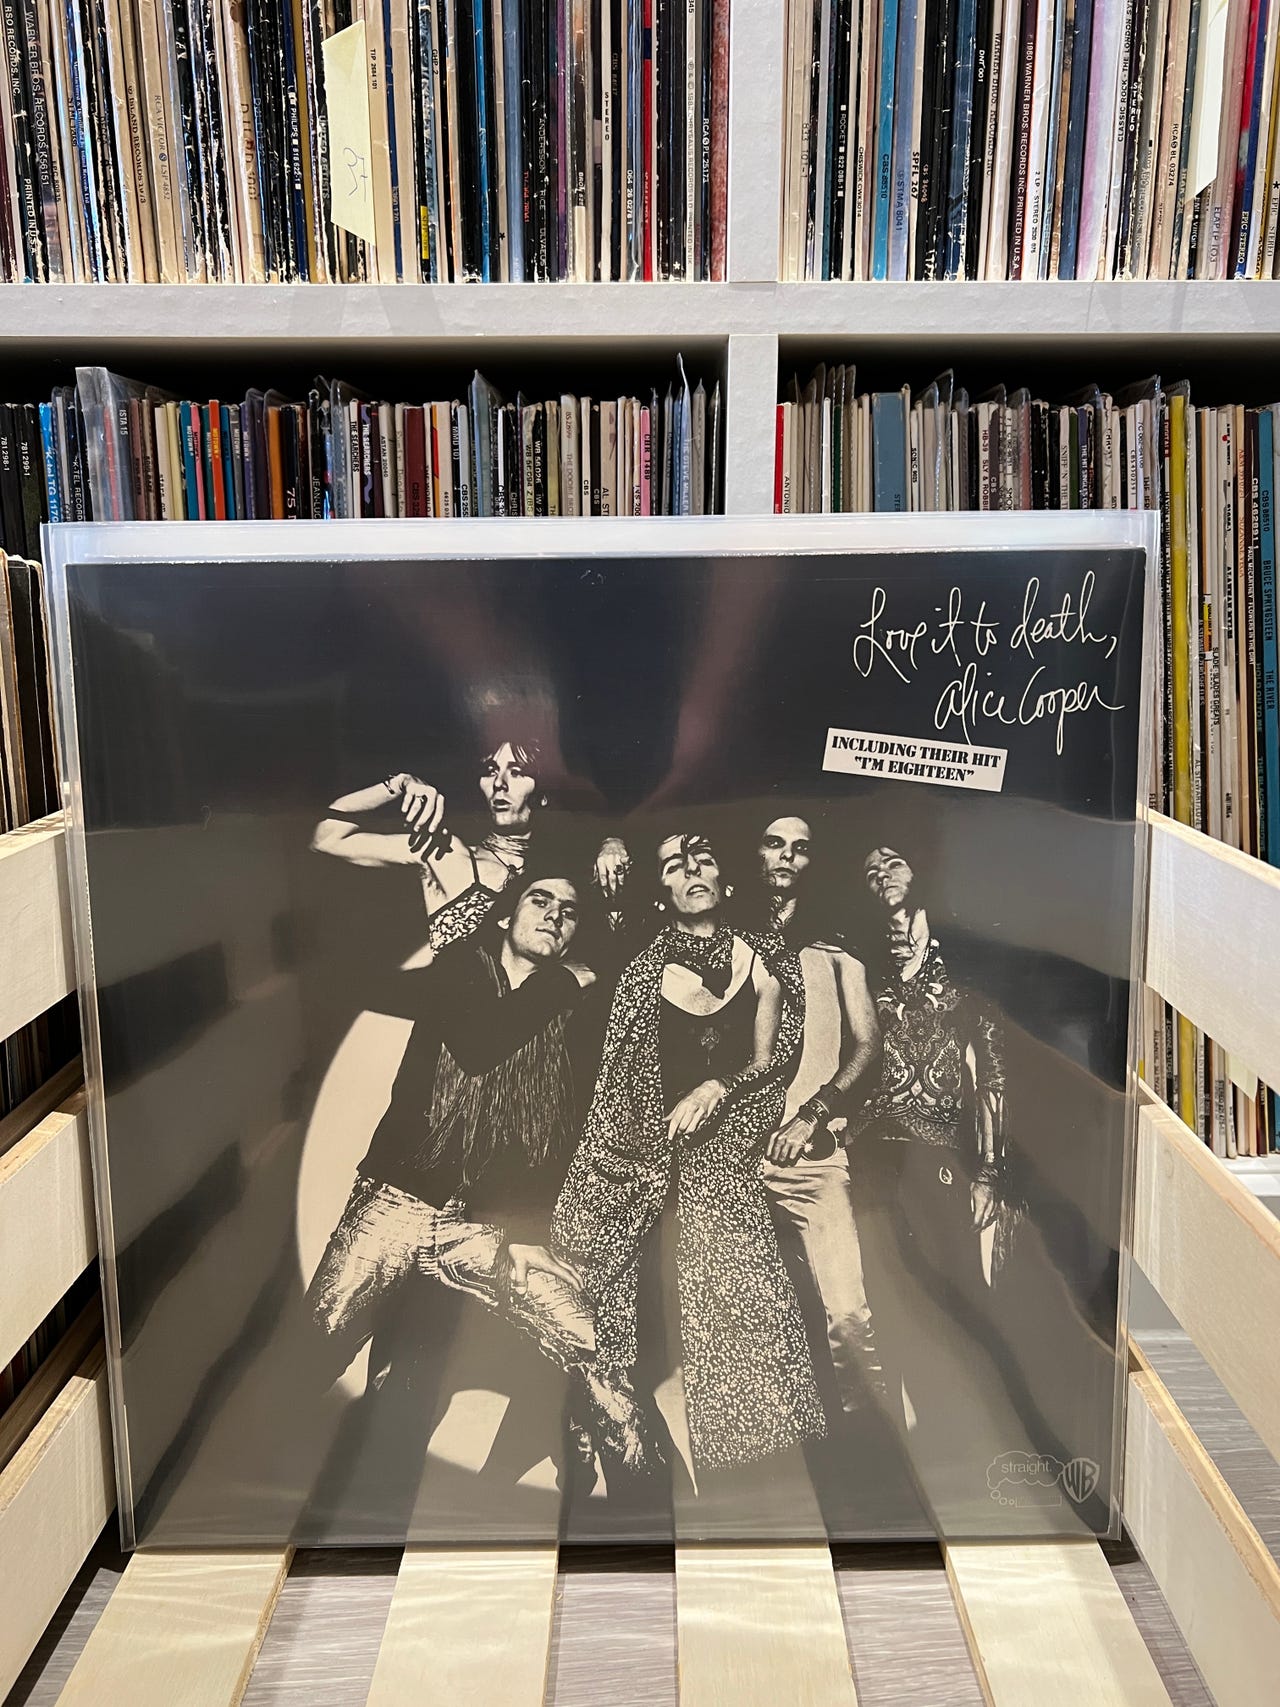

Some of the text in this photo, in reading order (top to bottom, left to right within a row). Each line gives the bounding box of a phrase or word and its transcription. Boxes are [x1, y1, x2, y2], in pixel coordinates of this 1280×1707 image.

[5, 6, 13, 25] RSO
[12, 78, 20, 96] INC.
[1023, 62, 1032, 101] WARNER
[25, 12, 37, 58] WARNER
[39, 152, 49, 185] K56151
[1022, 103, 1030, 131] BROS.
[1117, 107, 1126, 142] CLASSIC
[1171, 123, 1179, 141] RCA
[703, 146, 709, 156] PL
[882, 154, 890, 173] CBS
[1019, 132, 1027, 175] RECORDS
[1170, 151, 1177, 160] BL
[24, 179, 35, 216] PRINTED
[627, 189, 632, 198] 26
[29, 219, 36, 228] IN
[1015, 196, 1023, 234] PRINTED
[1267, 197, 1278, 257] EPIC STEREO
[1015, 236, 1021, 245] IN
[1191, 222, 1199, 249] VIRGIN
[1238, 233, 1246, 263] STEREO
[351, 434, 359, 472] SEARCHERS
[363, 437, 371, 476] SEARCHERS
[72, 461, 80, 484] K-TEL
[48, 480, 55, 496] TG
[286, 487, 295, 508] 75
[602, 487, 609, 499] AL
[1263, 560, 1272, 586] BRUCE
[1264, 589, 1273, 640] SPRINGSTEEN
[853, 587, 928, 684] Love
[931, 587, 965, 667] it
[970, 601, 1000, 656] to
[1266, 687, 1274, 709] RIVER
[831, 735, 1001, 768] INCLUDING THEIR HIT
